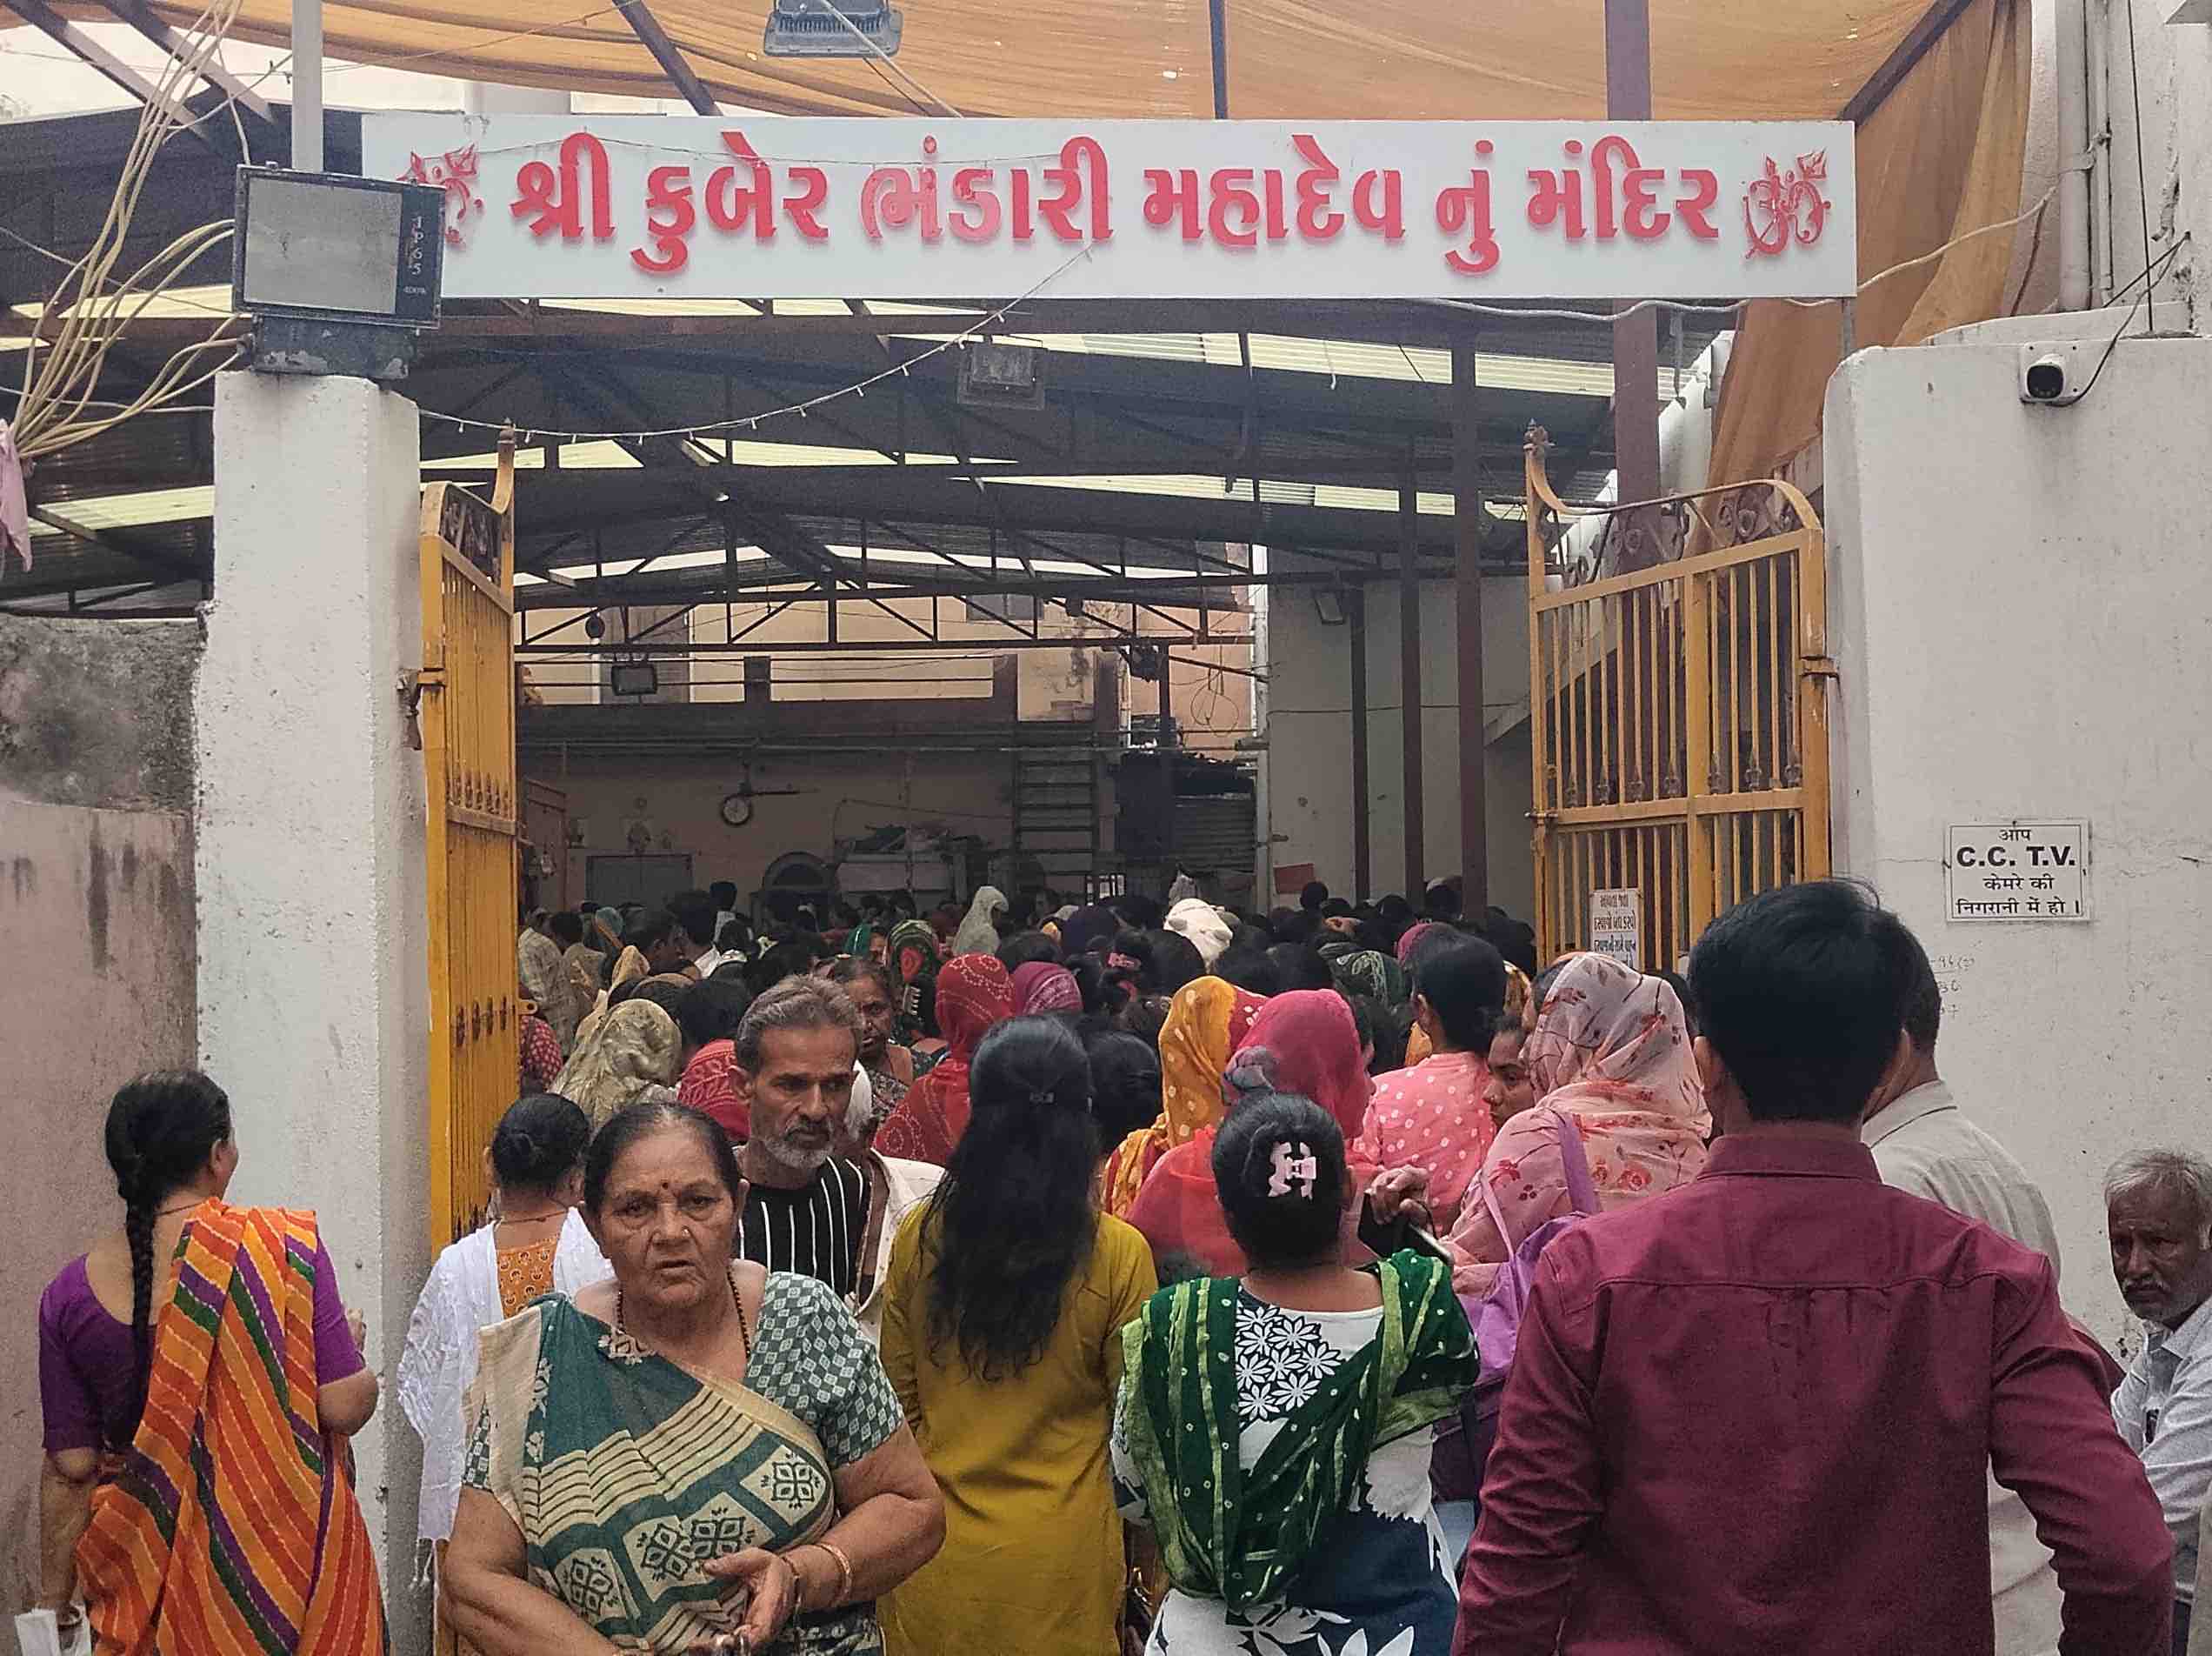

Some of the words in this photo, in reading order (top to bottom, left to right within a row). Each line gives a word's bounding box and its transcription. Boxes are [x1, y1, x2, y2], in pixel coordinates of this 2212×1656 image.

[510, 132, 615, 237] શ્રી
[630, 130, 830, 275] કુબેર
[860, 135, 1114, 244] ભંડારી
[1143, 133, 1403, 249] મહાદેવ
[1435, 139, 1501, 276] નું
[1526, 134, 1719, 242] મંદિર
[1998, 828, 2032, 843] आप
[1956, 845, 2016, 867] C.C.
[2025, 845, 2075, 867] T.V.
[1982, 872, 2025, 891] केमरे
[2029, 872, 2055, 891] की
[1955, 897, 2020, 915] निगरानी
[2026, 896, 2041, 913] में
